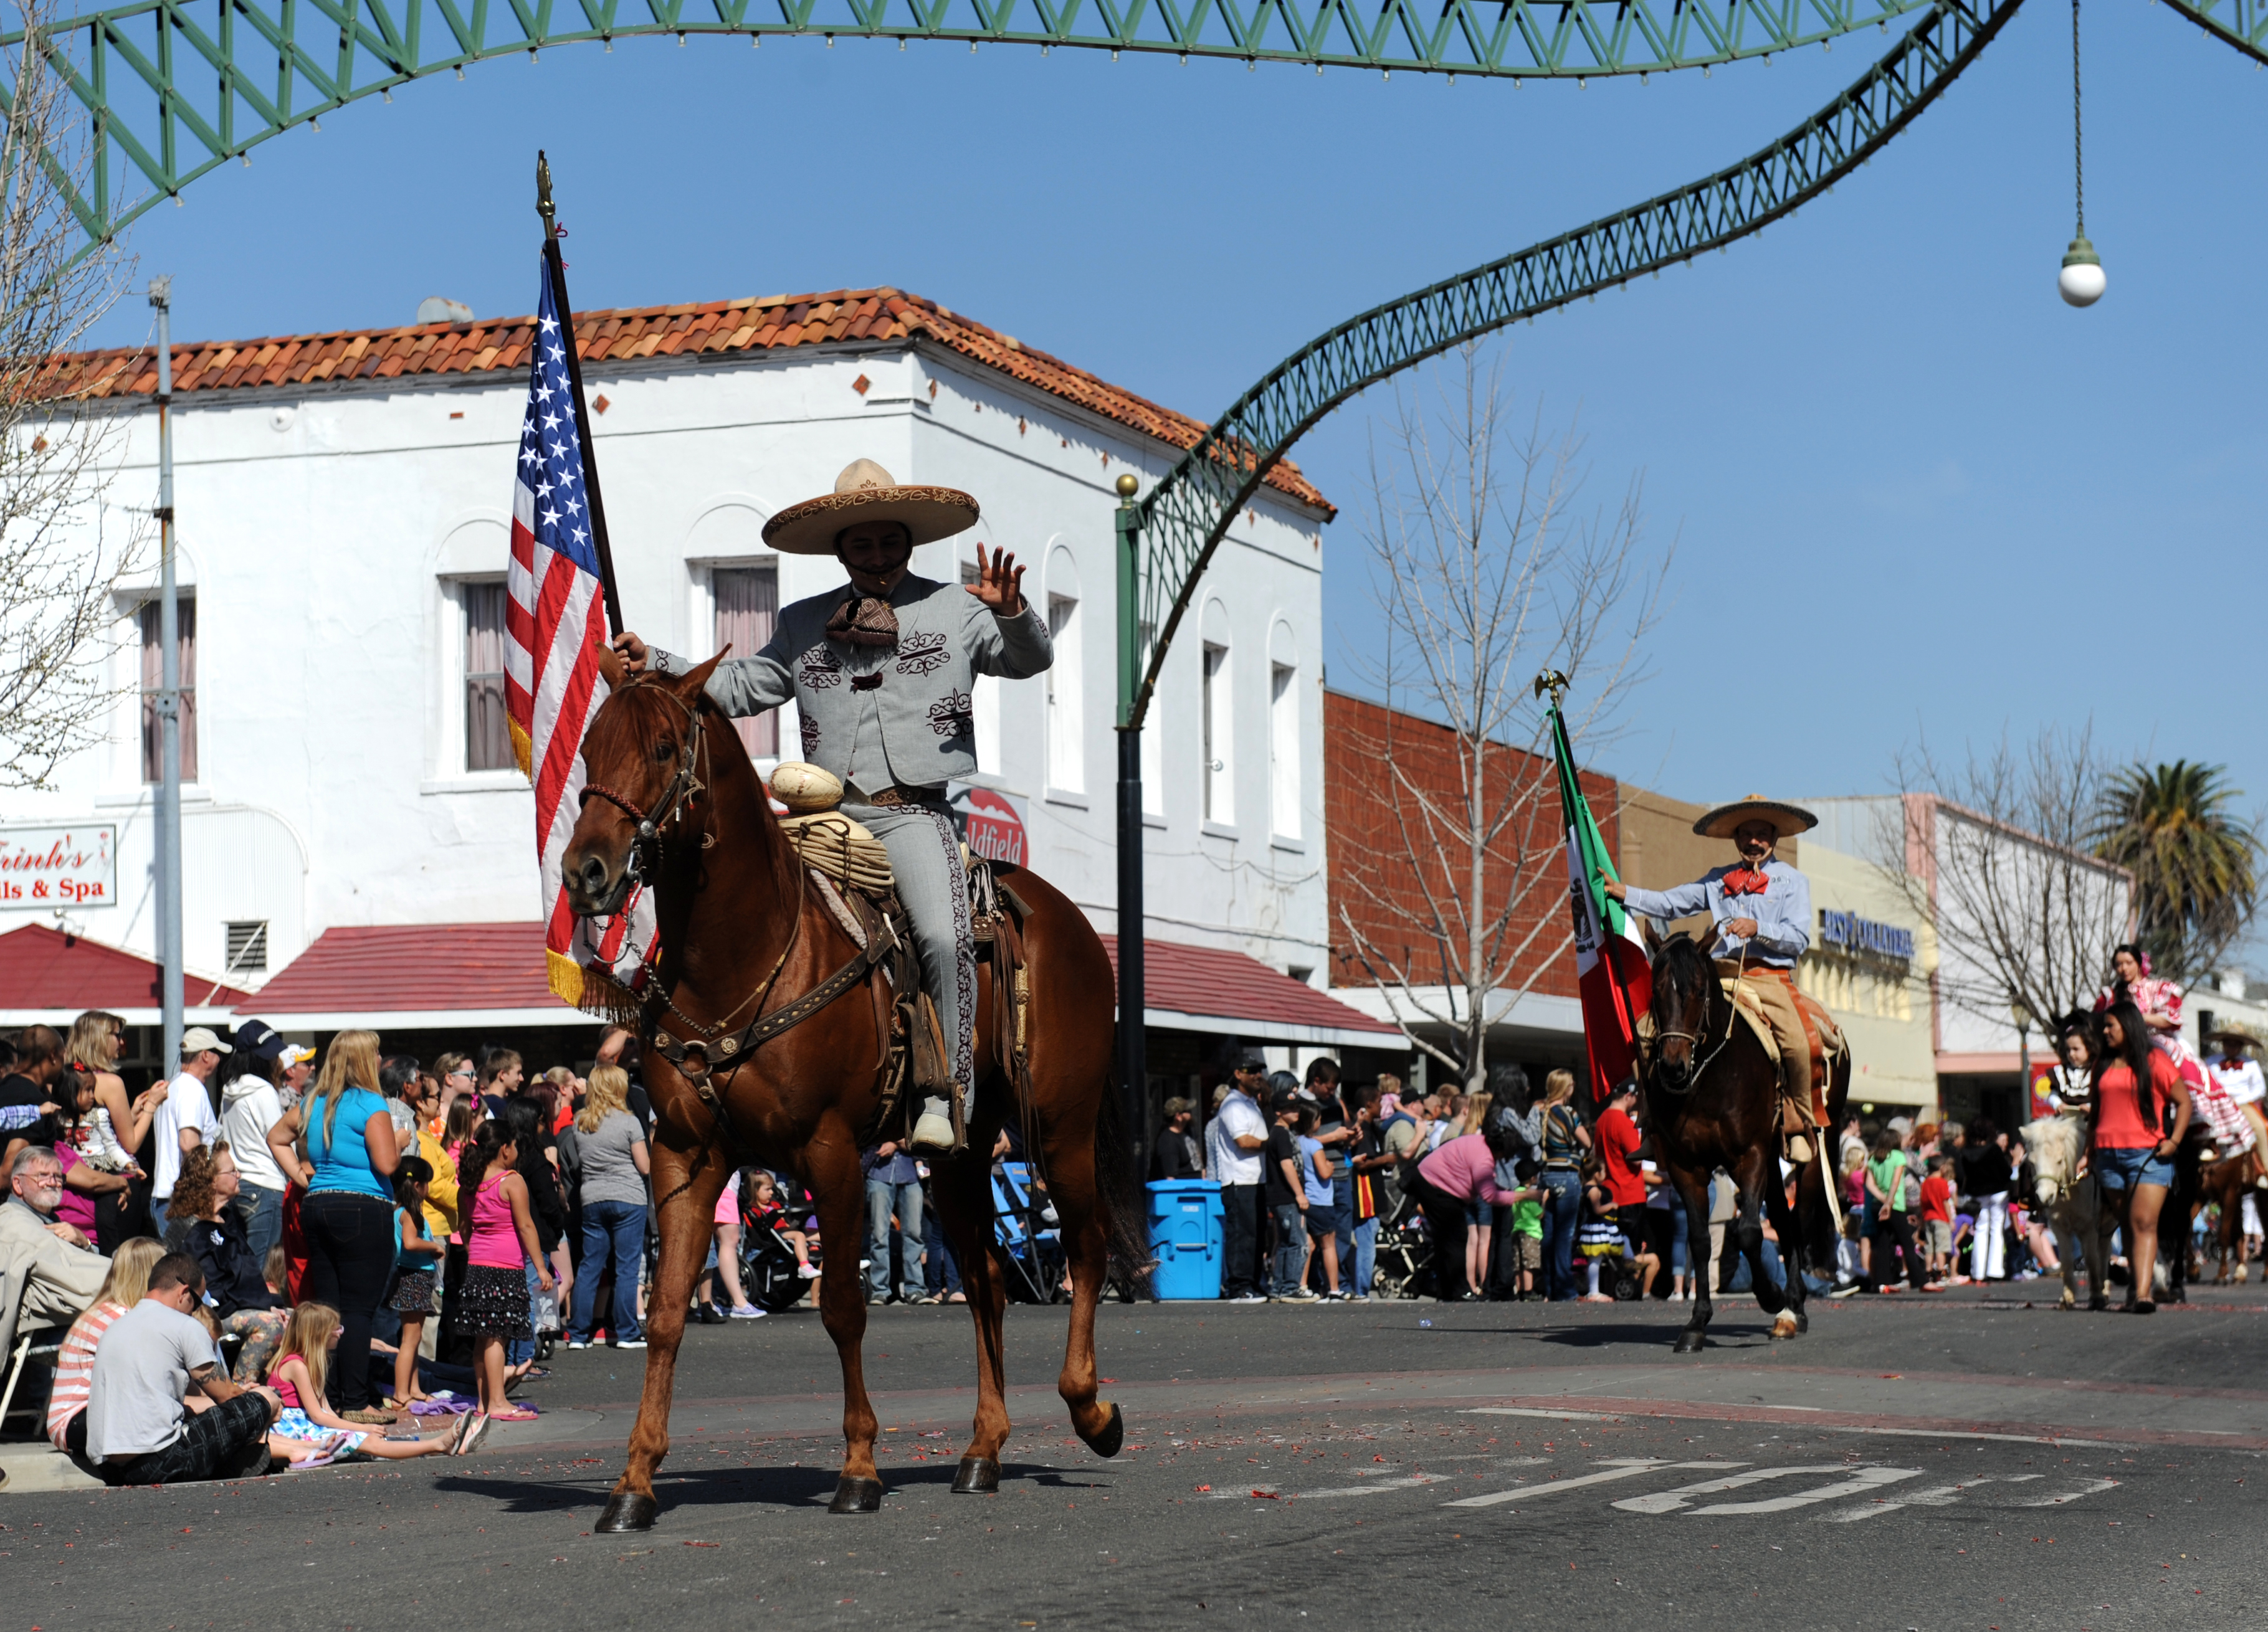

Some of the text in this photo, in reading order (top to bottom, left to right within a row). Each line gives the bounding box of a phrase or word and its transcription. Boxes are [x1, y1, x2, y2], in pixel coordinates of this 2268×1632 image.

[0, 833, 93, 872] rinh's
[953, 817, 1022, 865] oldfield
[0, 878, 104, 903] ls & Spa
[1824, 909, 1849, 945] BEST
